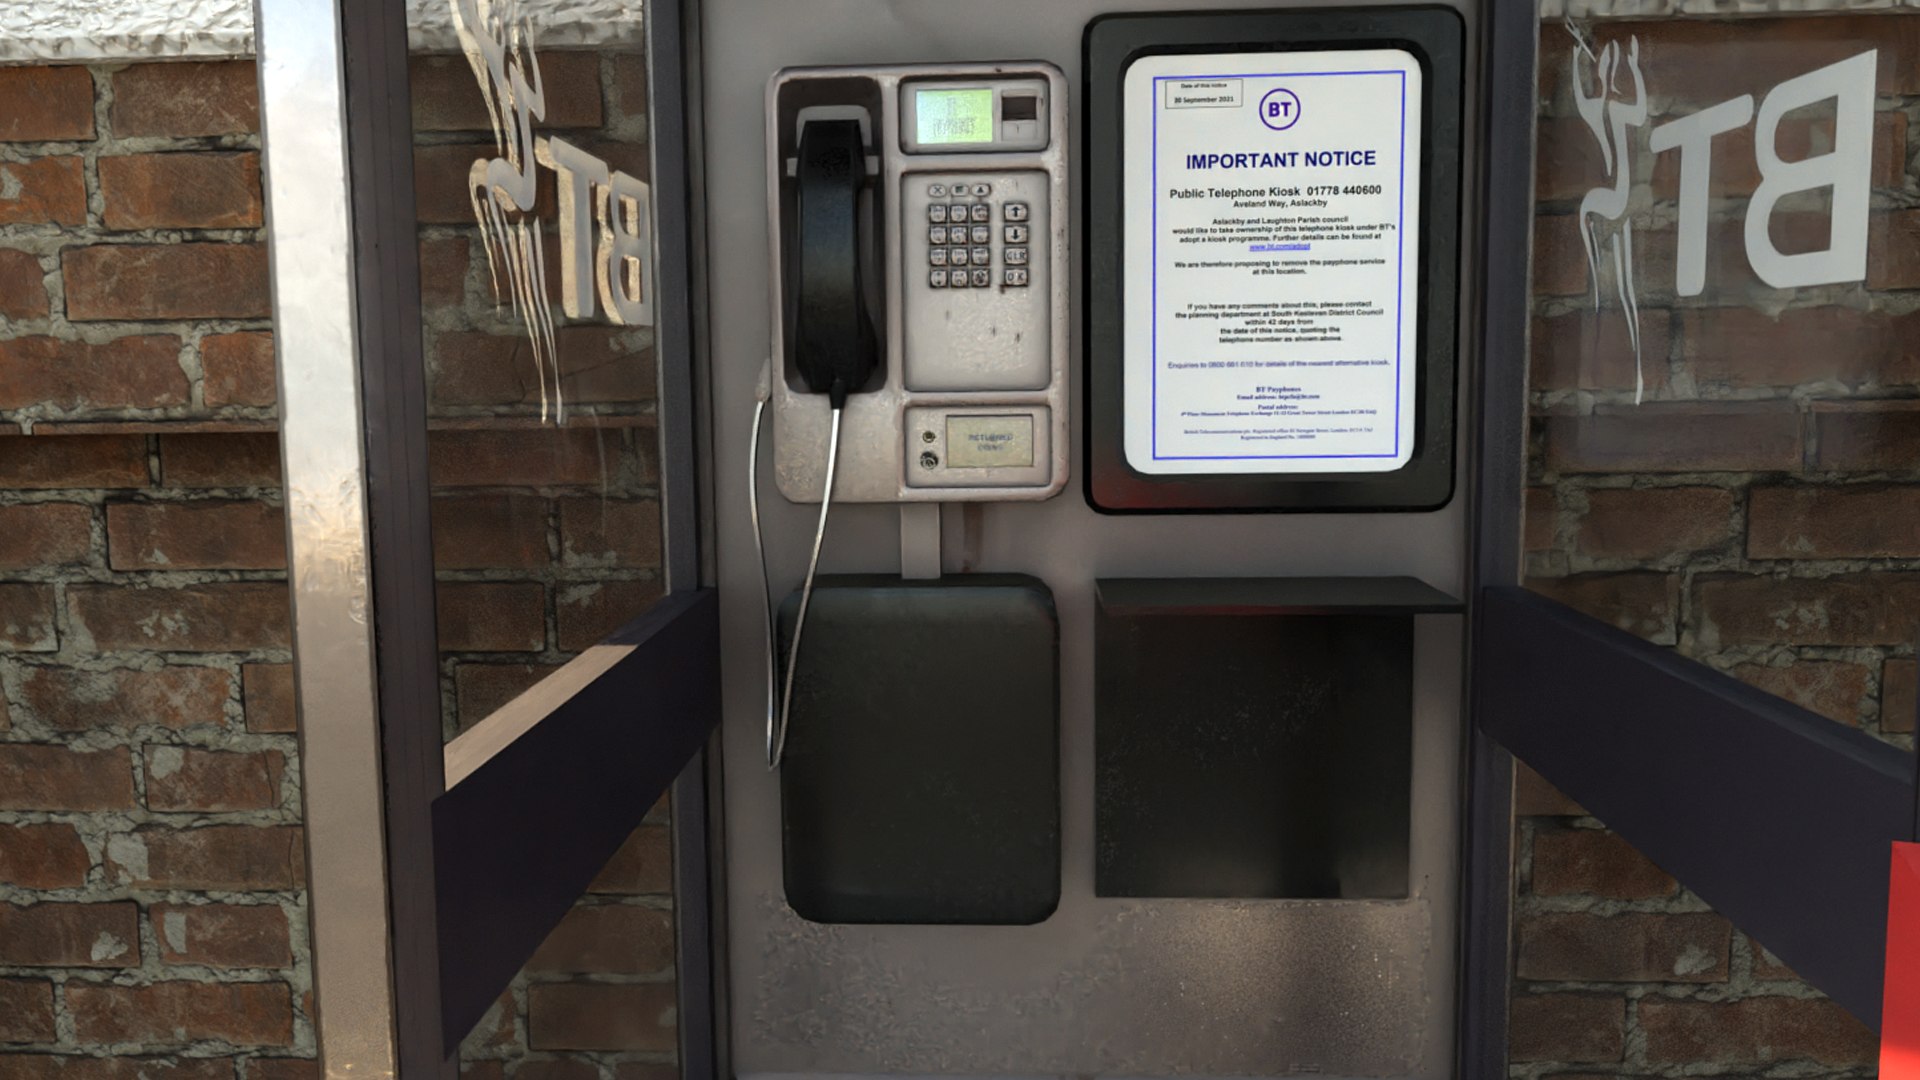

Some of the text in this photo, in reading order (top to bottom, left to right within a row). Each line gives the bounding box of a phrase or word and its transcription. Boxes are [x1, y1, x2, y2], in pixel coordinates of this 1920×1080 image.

[1183, 96, 1217, 104] September
[1269, 102, 1292, 117] BT
[1186, 151, 1376, 170] IMPORTANT NOTICE
[1170, 185, 1382, 200] Public Telephone Kiosk 01778 440600
[1233, 199, 1328, 209] Aveland Way, Aslackby
[1236, 226, 1273, 234] ownership
[1323, 259, 1358, 267] payphone
